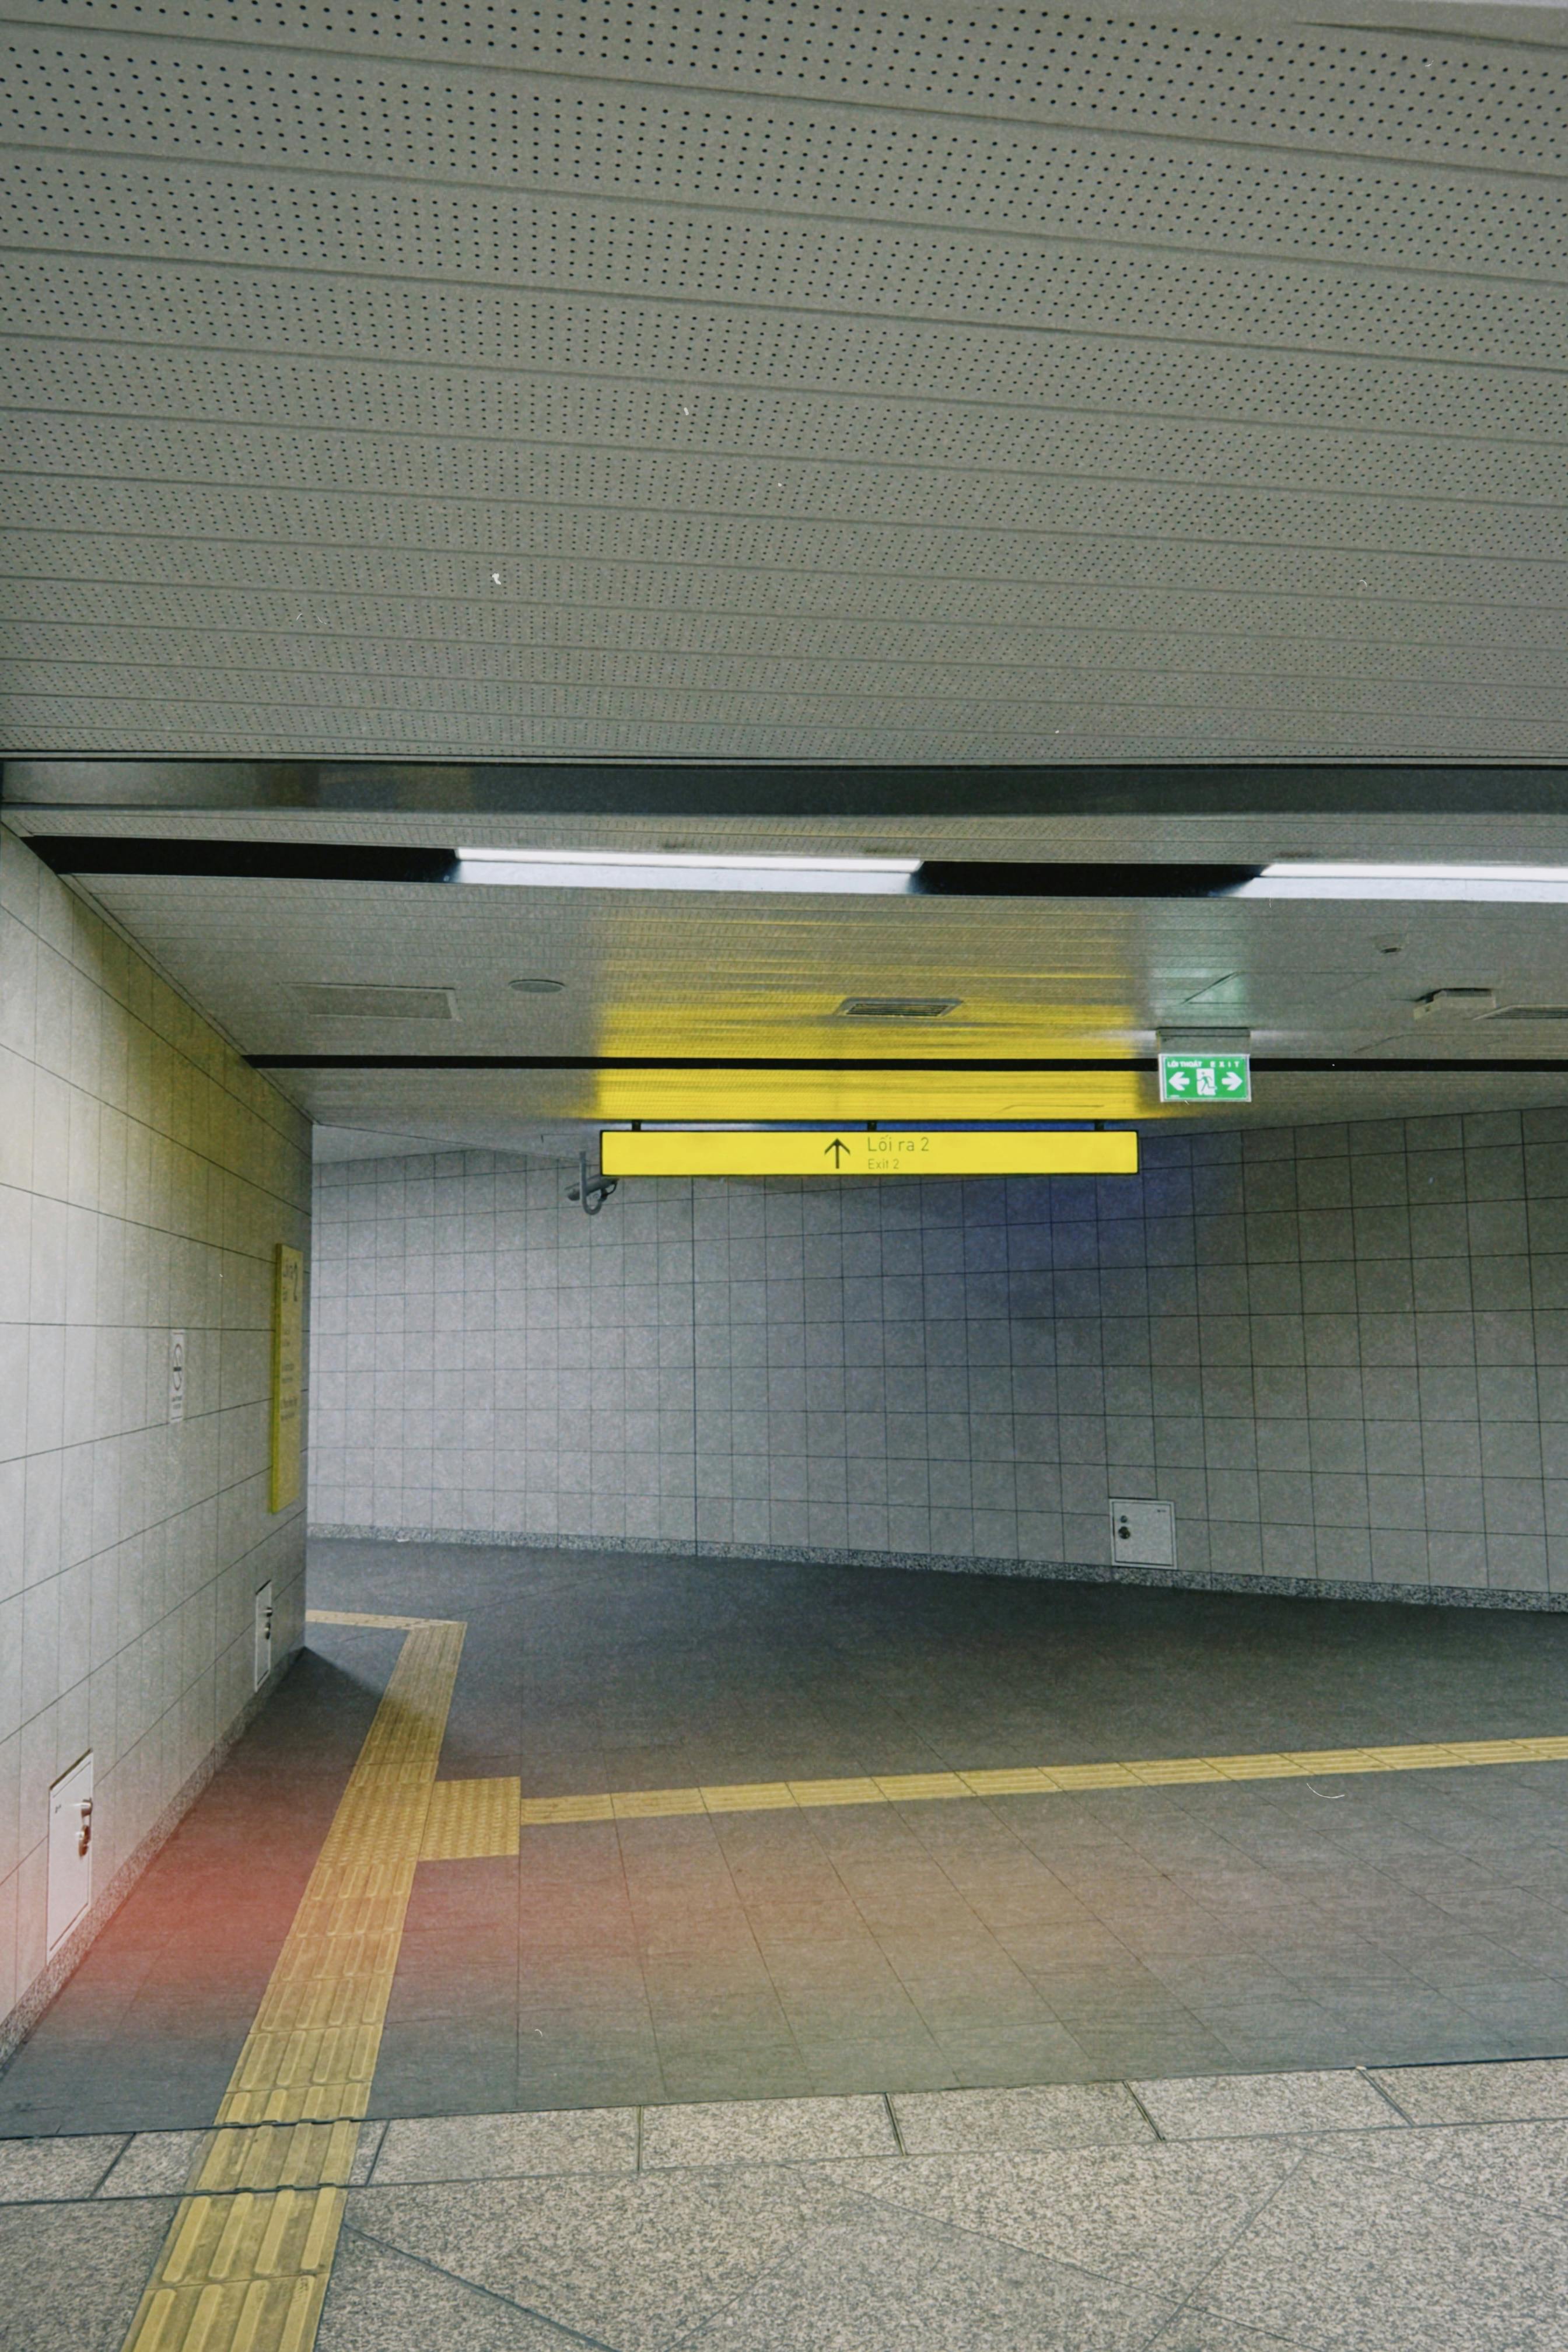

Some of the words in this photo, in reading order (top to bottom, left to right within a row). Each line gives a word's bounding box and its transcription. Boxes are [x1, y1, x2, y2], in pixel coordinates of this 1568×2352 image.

[867, 1135, 892, 1152] Lối
[898, 1140, 915, 1152] ra
[921, 1136, 929, 1152] 2
[868, 1158, 888, 1170] Exit
[892, 1158, 900, 1170] 2
